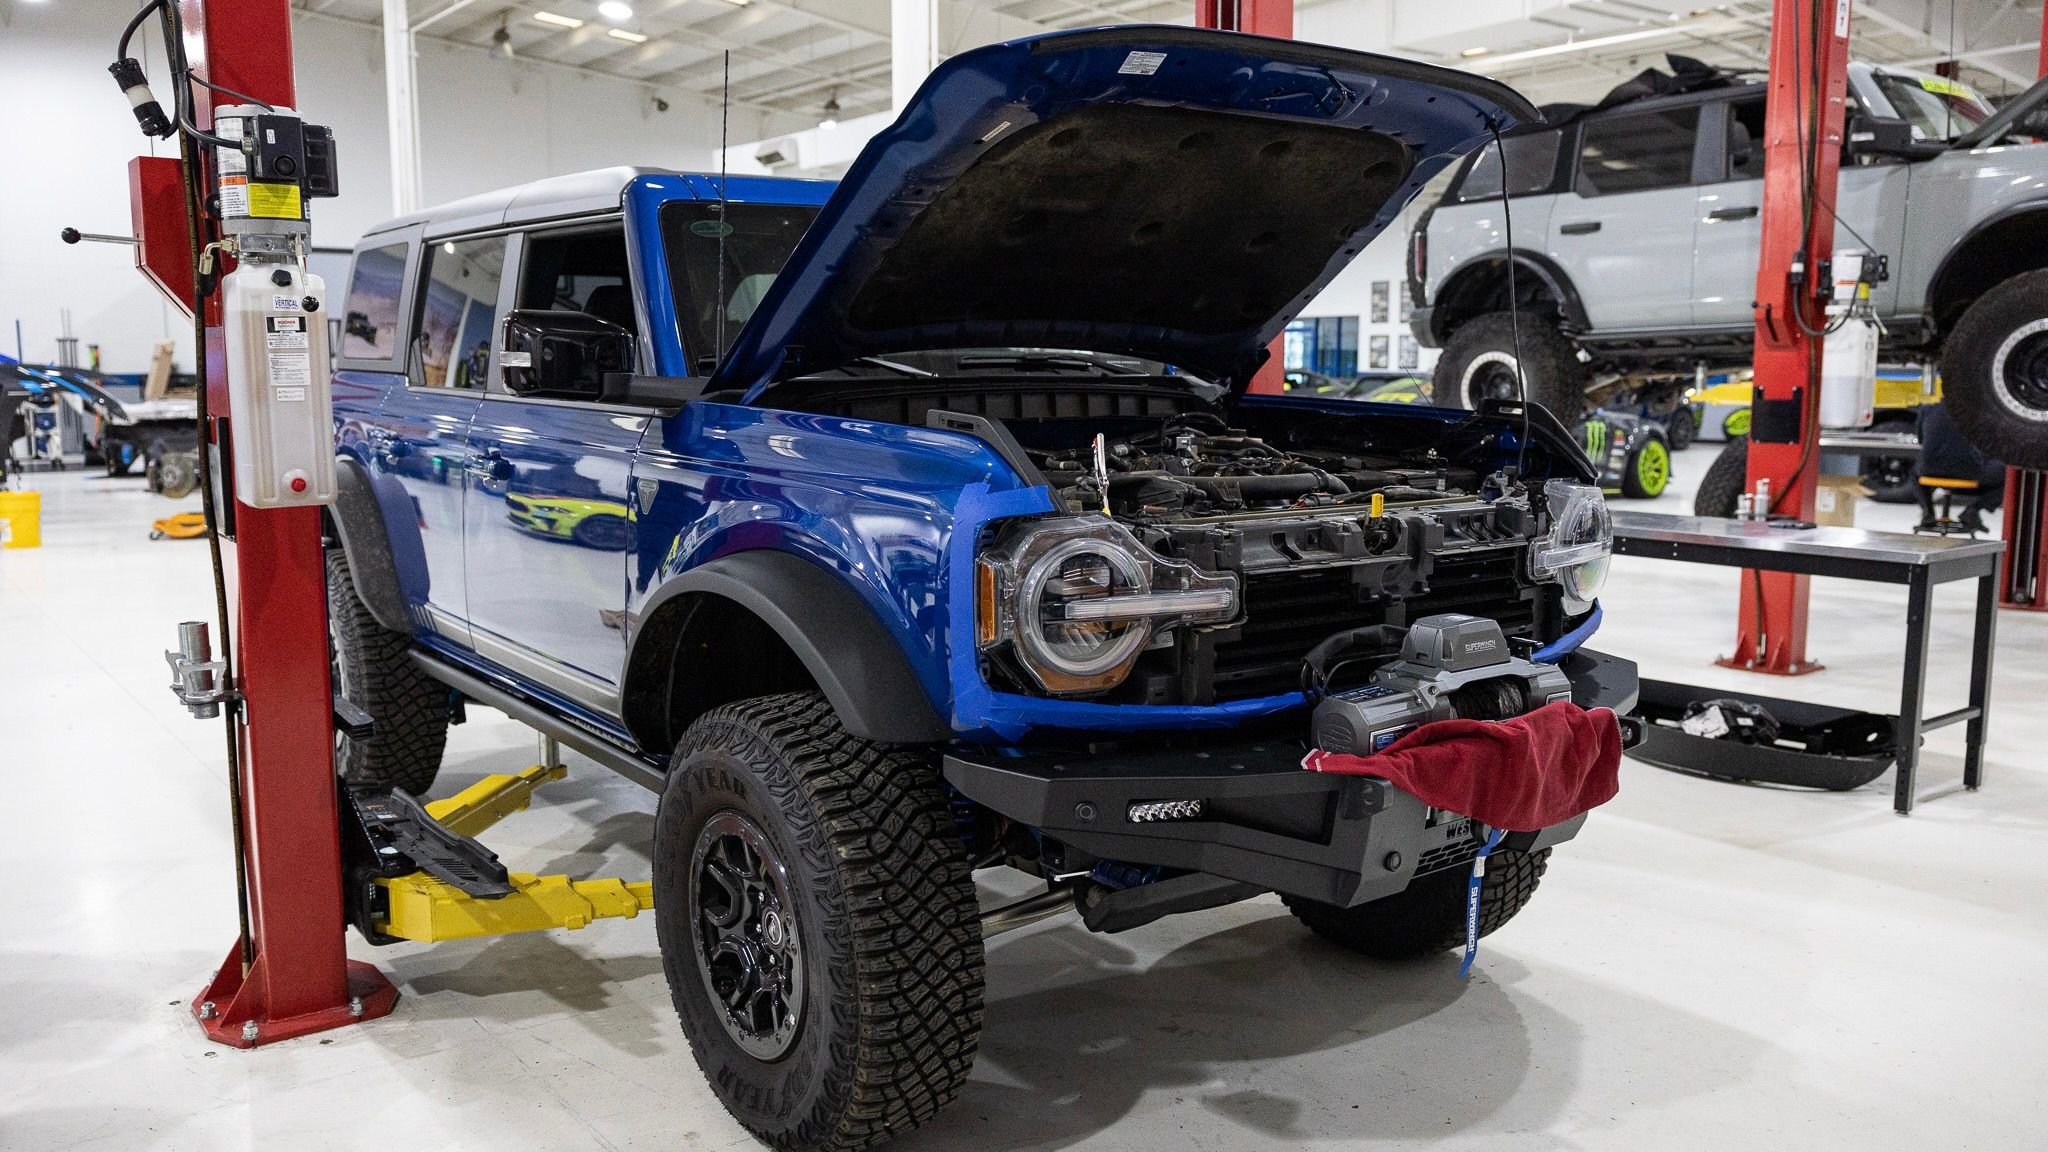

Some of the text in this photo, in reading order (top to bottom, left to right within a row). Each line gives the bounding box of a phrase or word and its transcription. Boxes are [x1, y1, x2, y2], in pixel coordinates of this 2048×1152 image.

[275, 299, 298, 307] VERTICAL
[1465, 640, 1496, 651] SUPERWINCH
[1446, 819, 1470, 840] WES
[1467, 886, 1479, 953] SUPERWINCH
